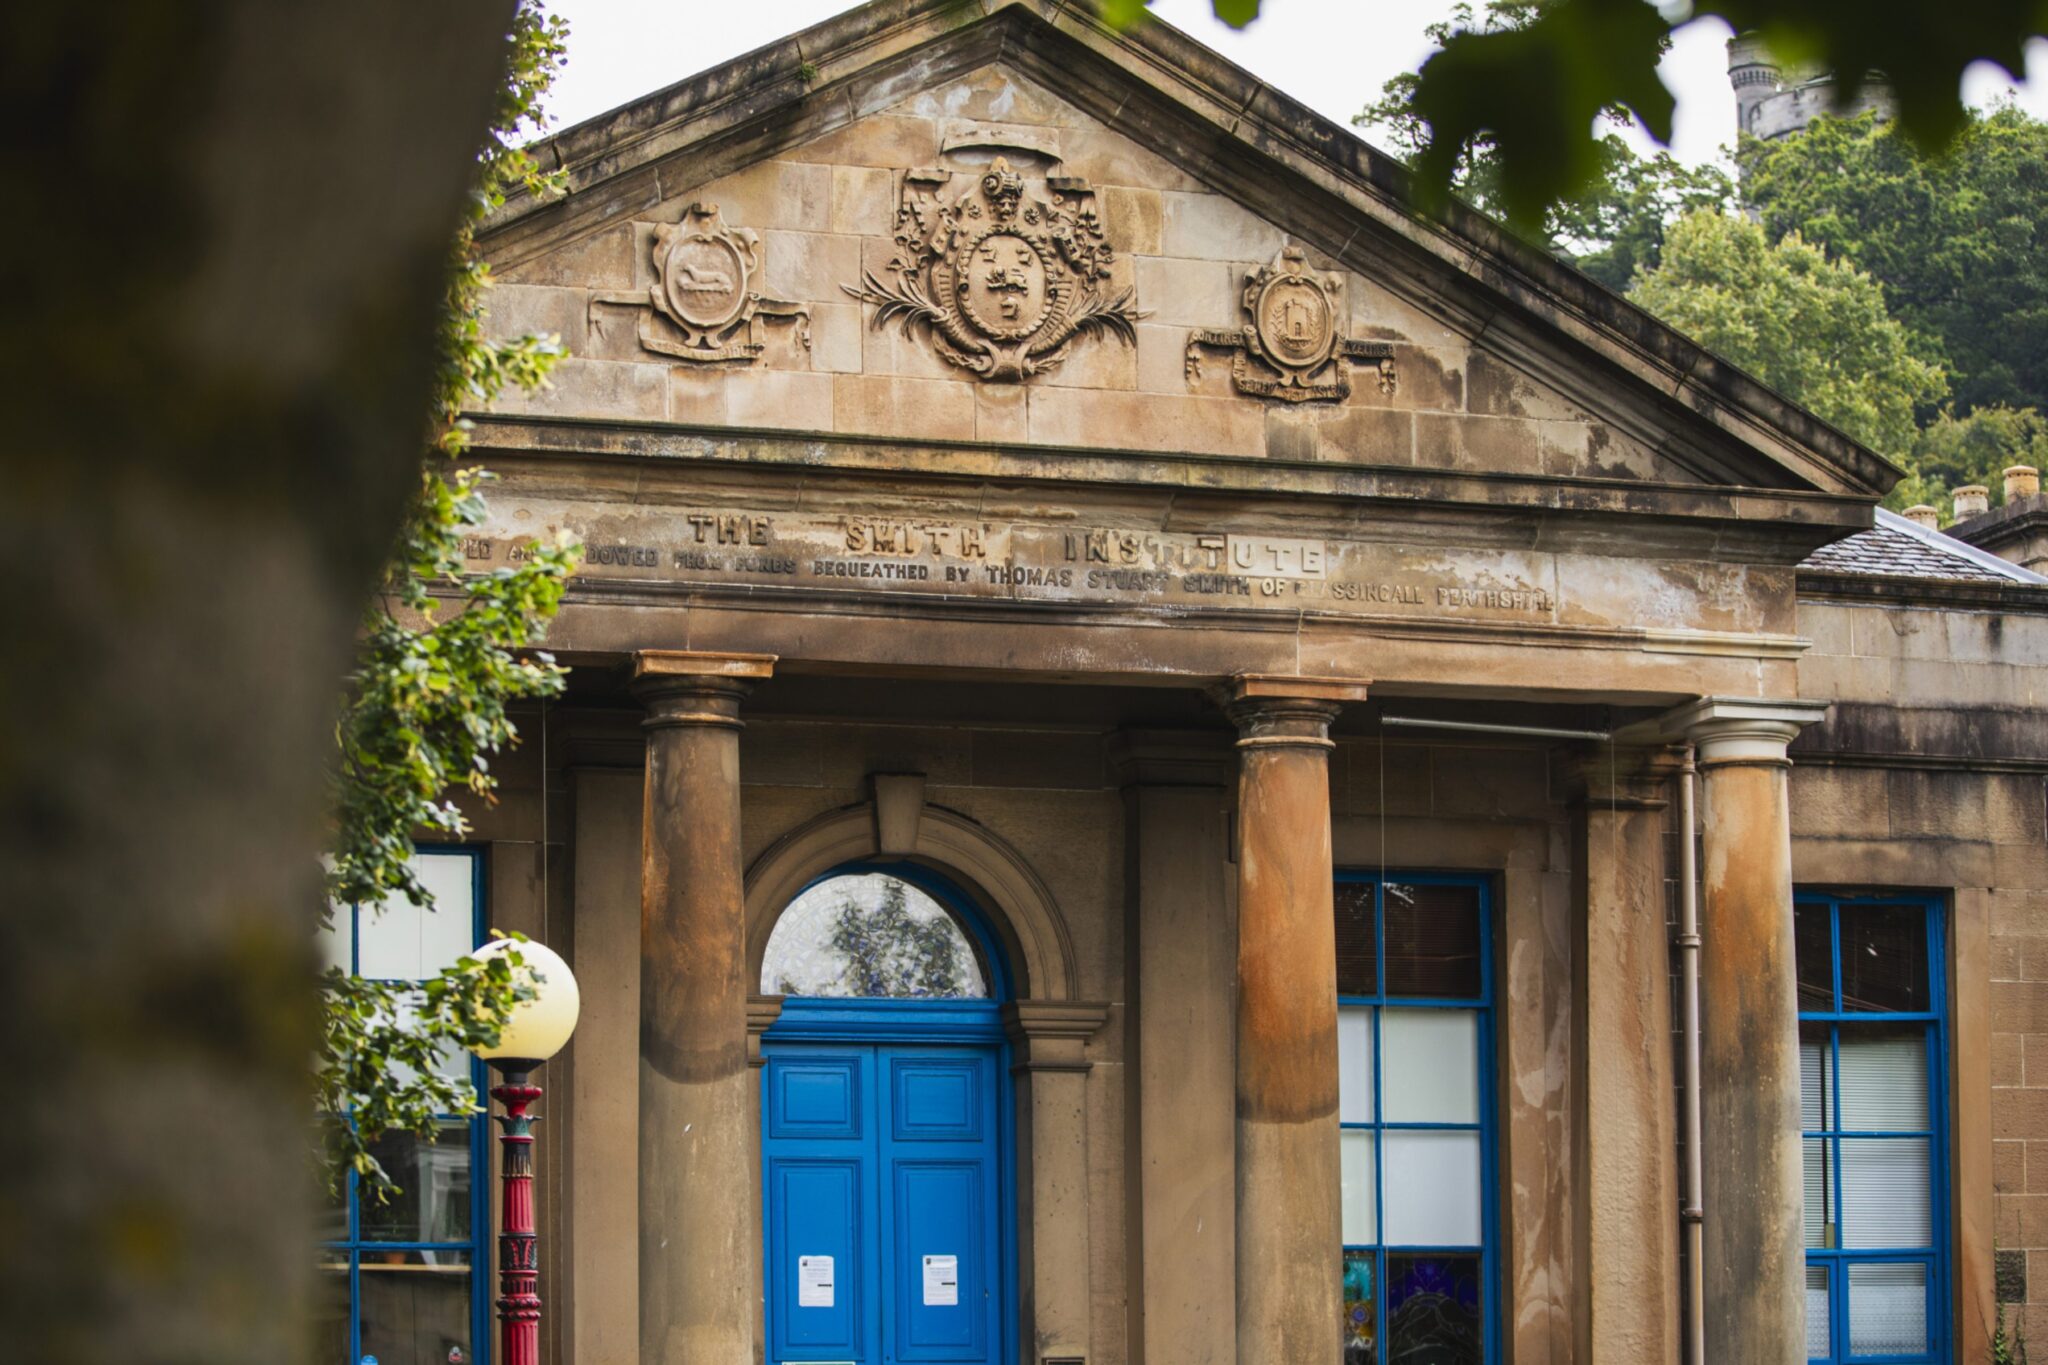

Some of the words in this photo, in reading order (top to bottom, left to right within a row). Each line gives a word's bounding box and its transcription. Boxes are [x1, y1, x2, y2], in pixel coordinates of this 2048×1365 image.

[687, 514, 770, 546] THE
[846, 517, 987, 558] SMITH
[1064, 533, 1323, 574] INSTITUTE
[674, 551, 722, 571] FROM
[735, 556, 797, 574] FUNDS
[814, 560, 929, 581] BEQUEATHED
[945, 565, 970, 583] BY
[986, 564, 1073, 588] THOMAS
[1087, 569, 1169, 592] STUART
[1183, 573, 1250, 596] SMITH
[1261, 577, 1286, 597] OF
[1437, 587, 1554, 612] PERTHSHIRE
